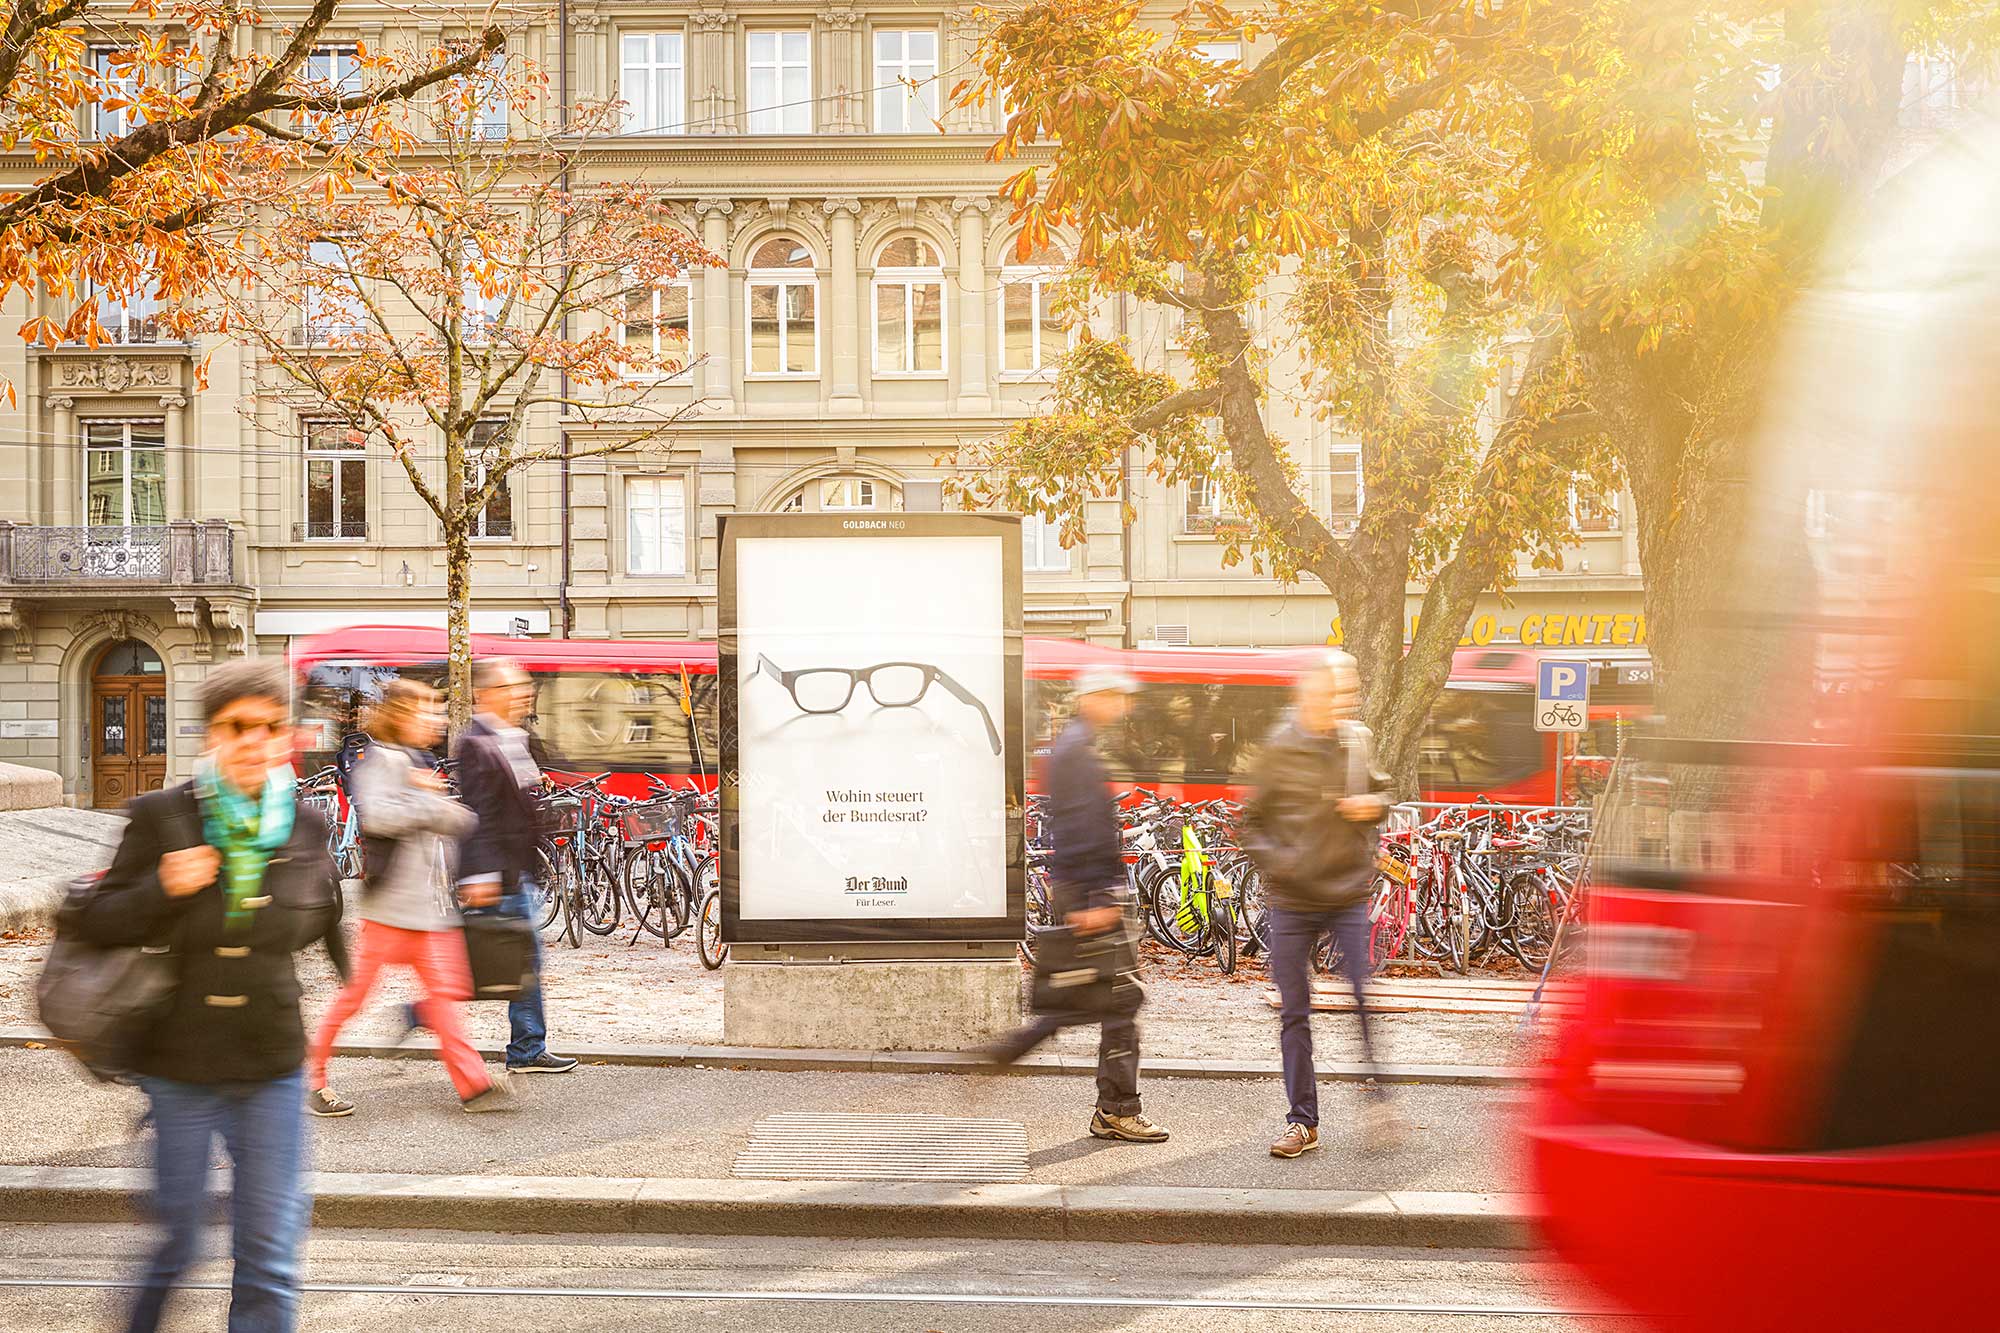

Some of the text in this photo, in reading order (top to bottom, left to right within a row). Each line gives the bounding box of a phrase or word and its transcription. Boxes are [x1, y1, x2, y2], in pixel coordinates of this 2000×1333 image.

[843, 520, 906, 530] GOLDBACH NEO
[1551, 667, 1577, 697] P
[826, 789, 924, 803] Wohin steuert
[822, 808, 928, 823] der Bundesrat?
[844, 876, 908, 891] Der Bund
[856, 898, 896, 907] Für Leser.
